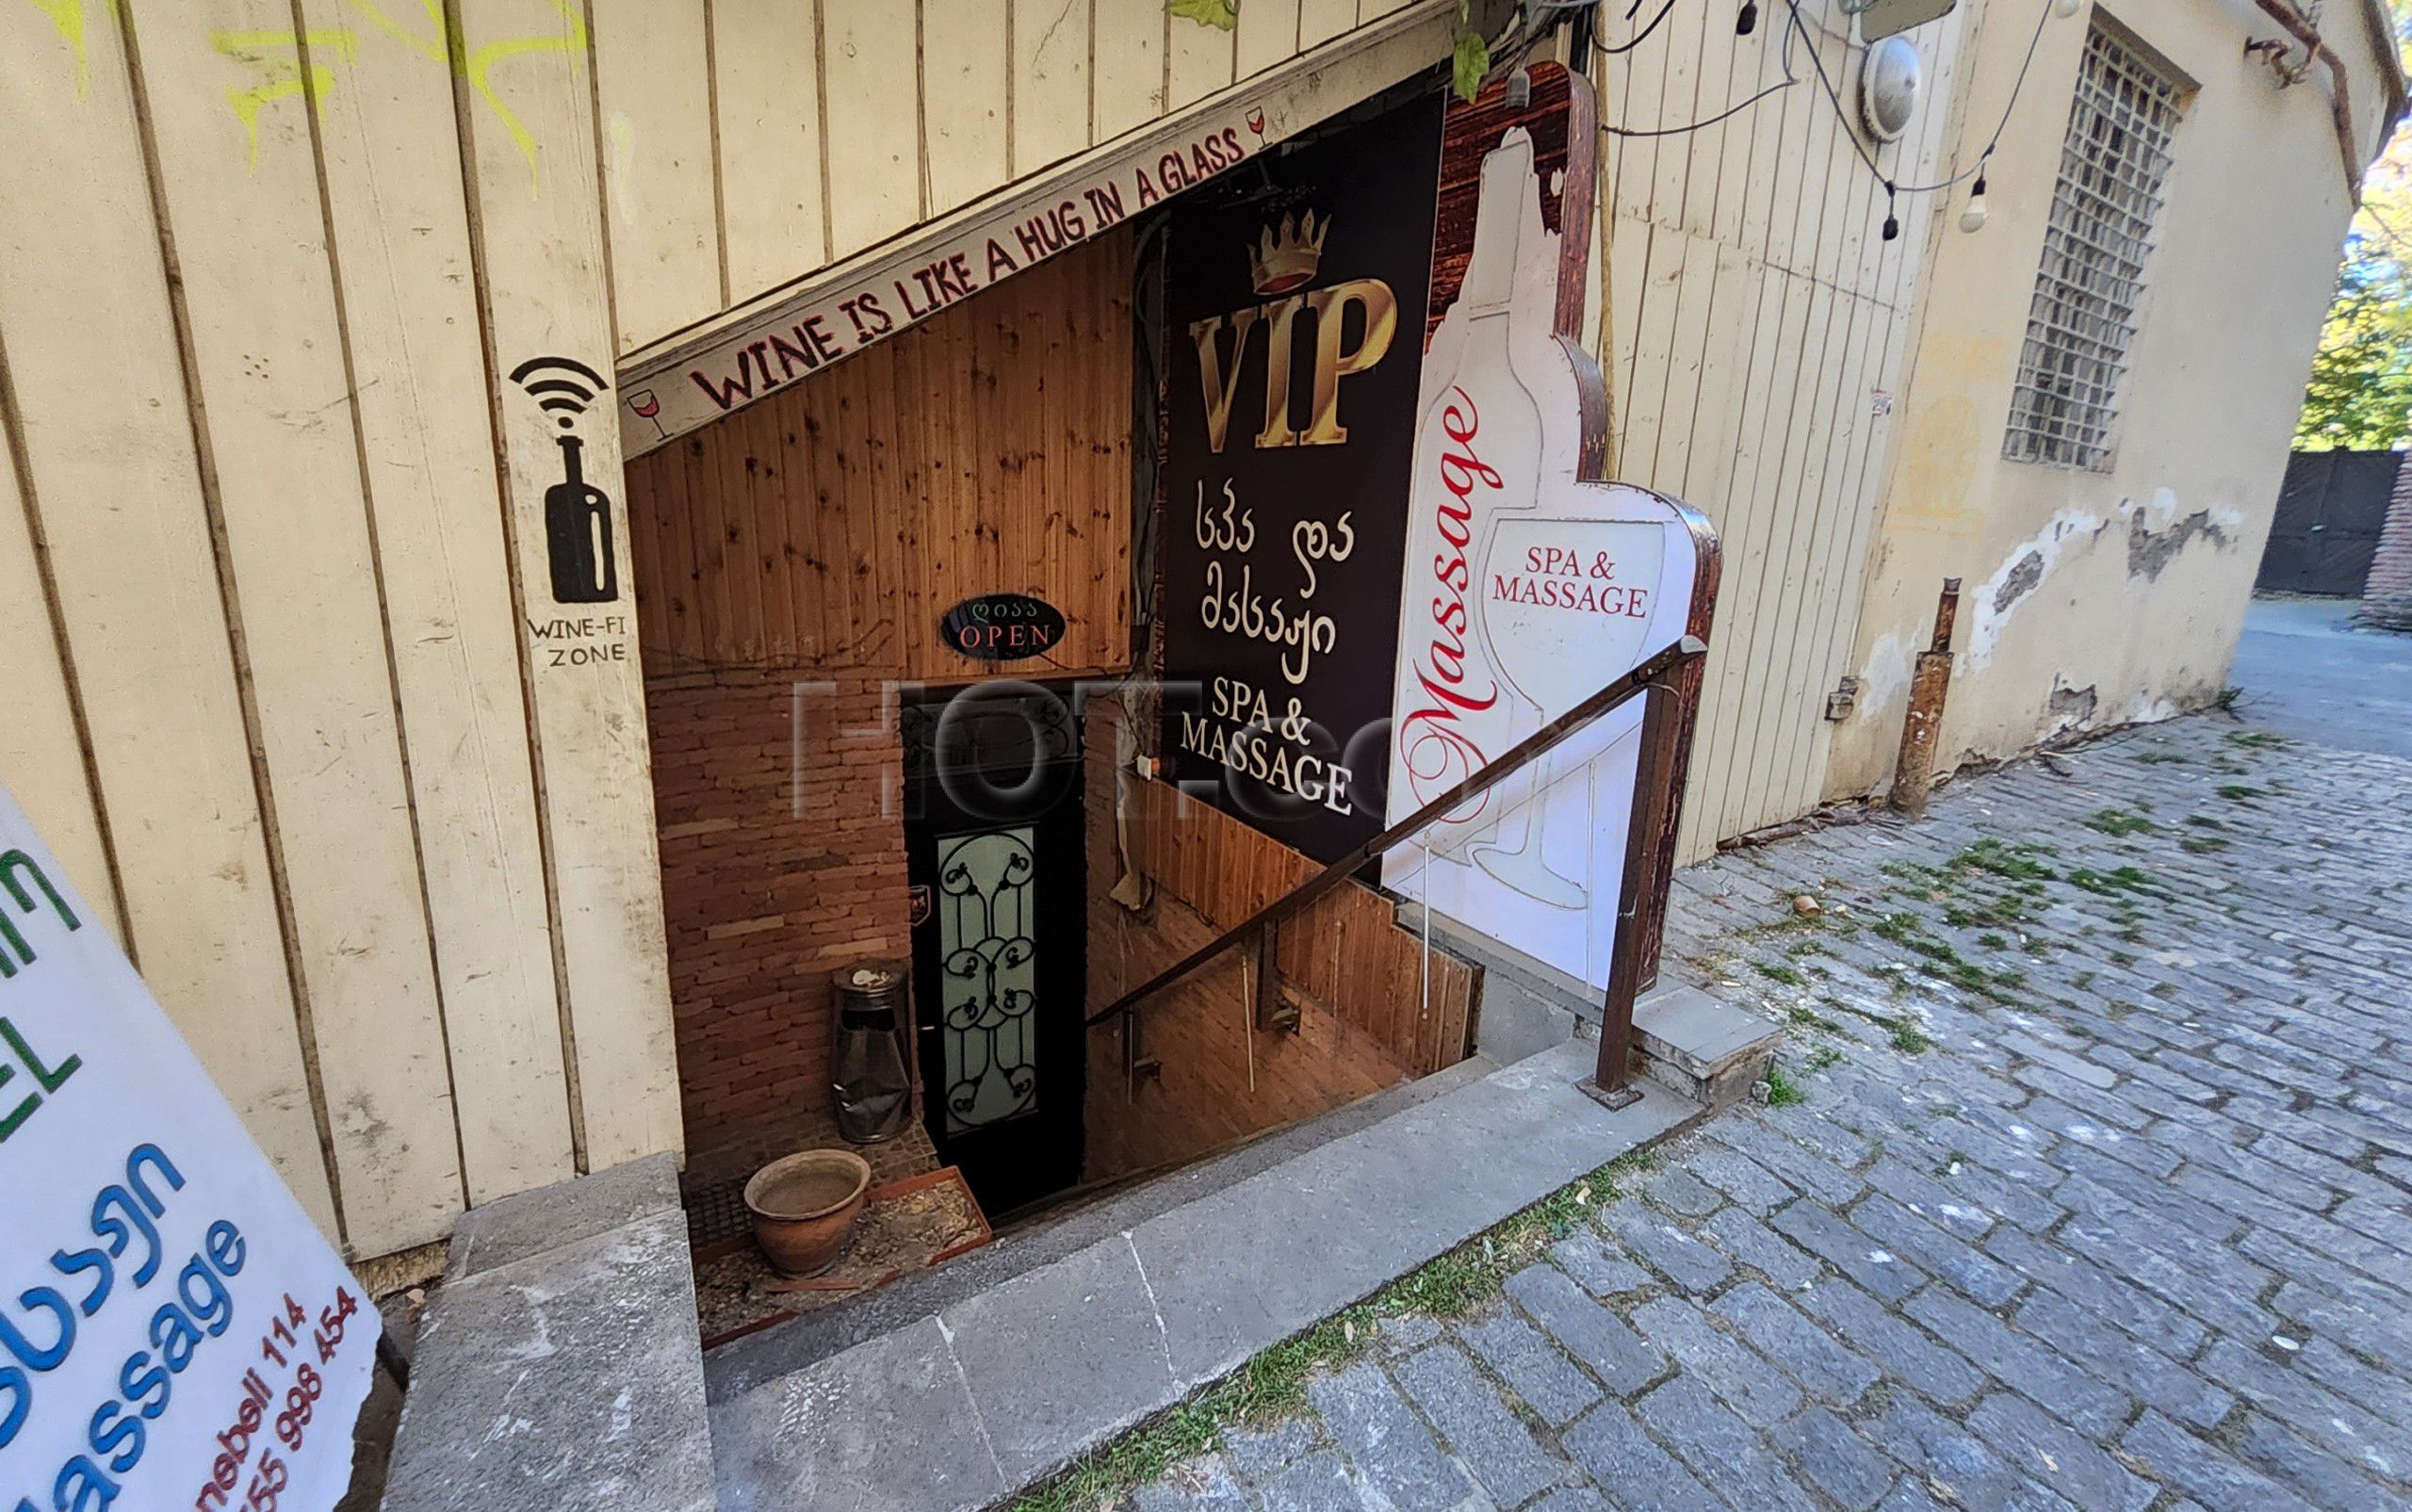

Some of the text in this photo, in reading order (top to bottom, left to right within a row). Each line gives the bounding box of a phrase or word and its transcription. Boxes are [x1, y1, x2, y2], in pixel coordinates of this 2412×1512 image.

[689, 128, 1246, 411] WINE IS LIKE A HUG IN A GLASS
[1188, 278, 1398, 454] VIP
[1196, 478, 1354, 598] სპა და
[1524, 546, 1615, 579] SPA &
[528, 616, 626, 639] WINE-FI
[959, 625, 1051, 648] OPEN
[1201, 561, 1336, 684] მასაჟი
[1399, 385, 1504, 824] Massage
[1492, 575, 1648, 619] MASSAGE
[547, 643, 626, 667] ZONE
[1213, 676, 1312, 745] SPA &
[1180, 711, 1352, 816] MASSAGE
[14, 1220, 247, 1512] assage
[262, 1293, 306, 1368] 114
[239, 1286, 357, 1512] 55 998 454
